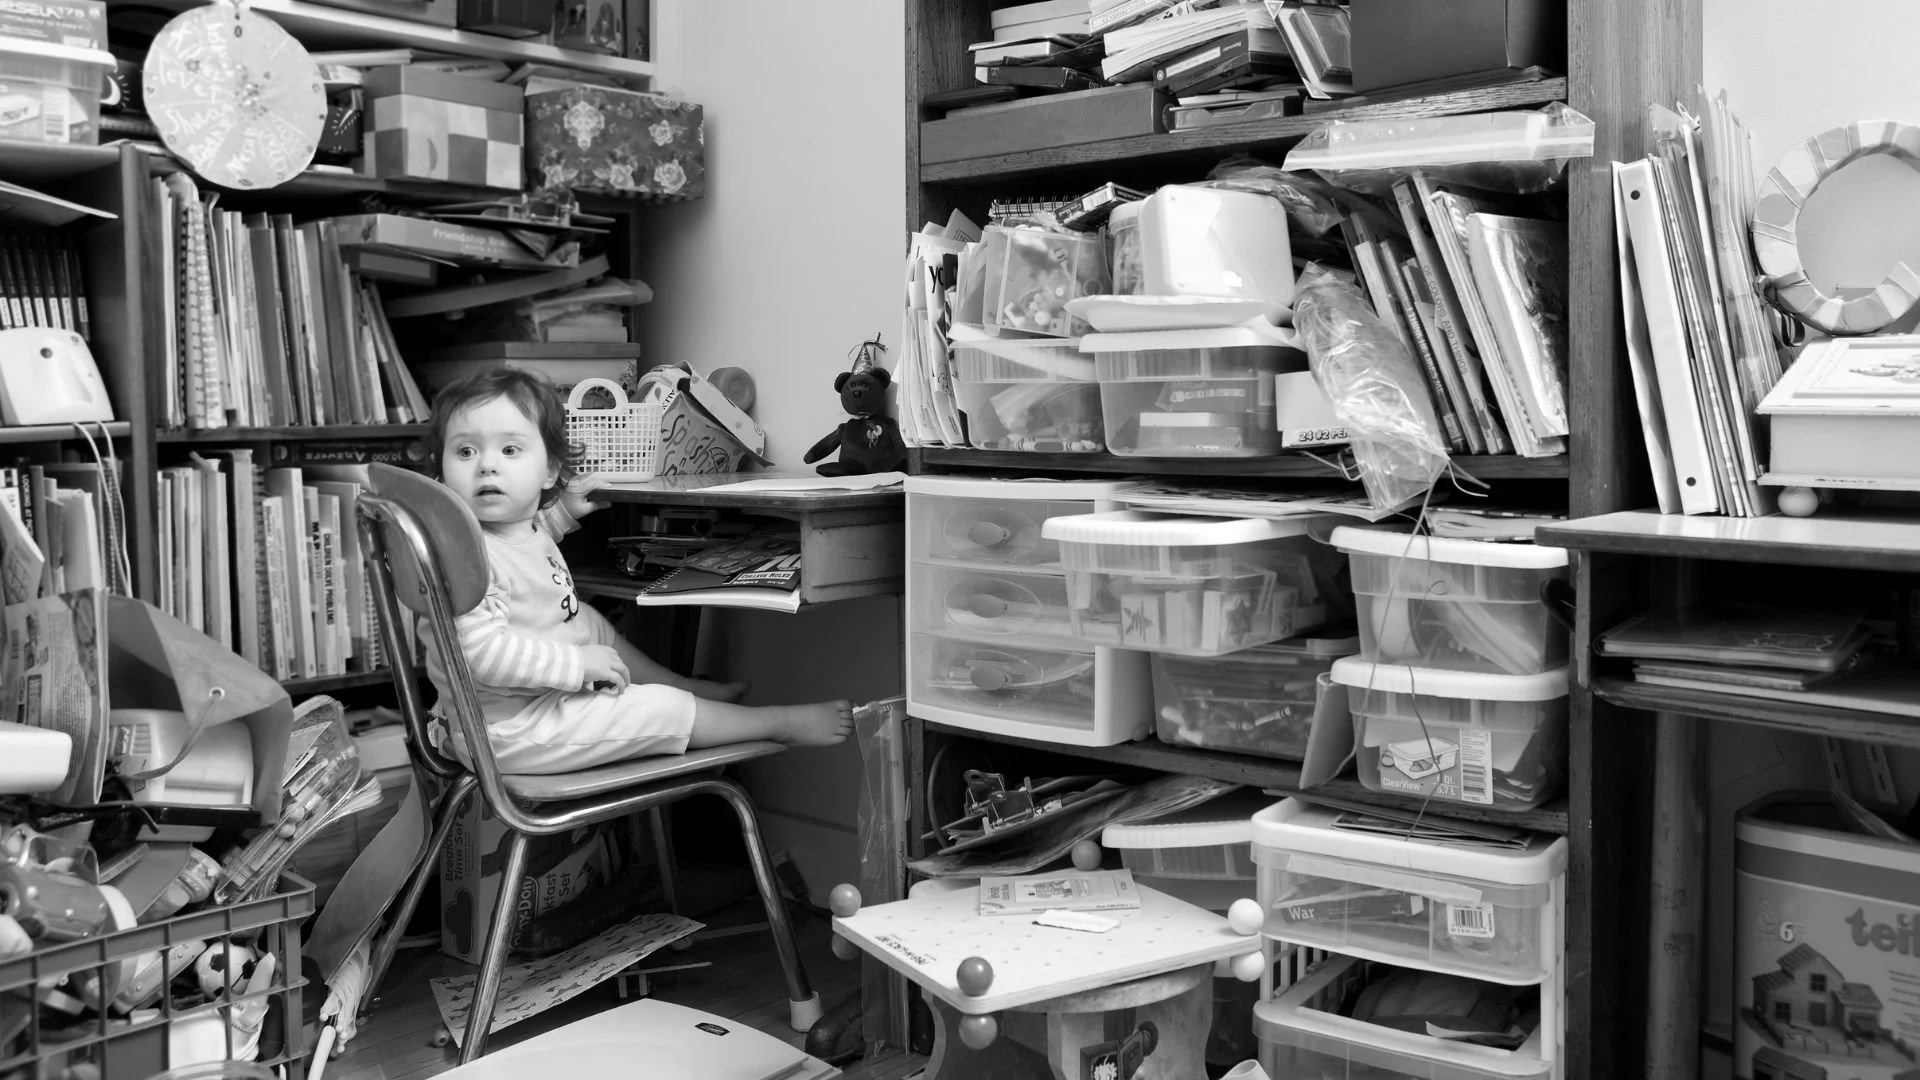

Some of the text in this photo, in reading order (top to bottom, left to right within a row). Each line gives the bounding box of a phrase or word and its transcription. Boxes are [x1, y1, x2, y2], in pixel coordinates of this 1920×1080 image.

[22, 474, 32, 507] LOOKING
[312, 521, 321, 550] MAP
[323, 533, 336, 626] CHILDREN SOLVE PROBLEMS
[454, 822, 463, 881] Time Set
[1288, 906, 1316, 921] War
[1779, 921, 1796, 942] 6
